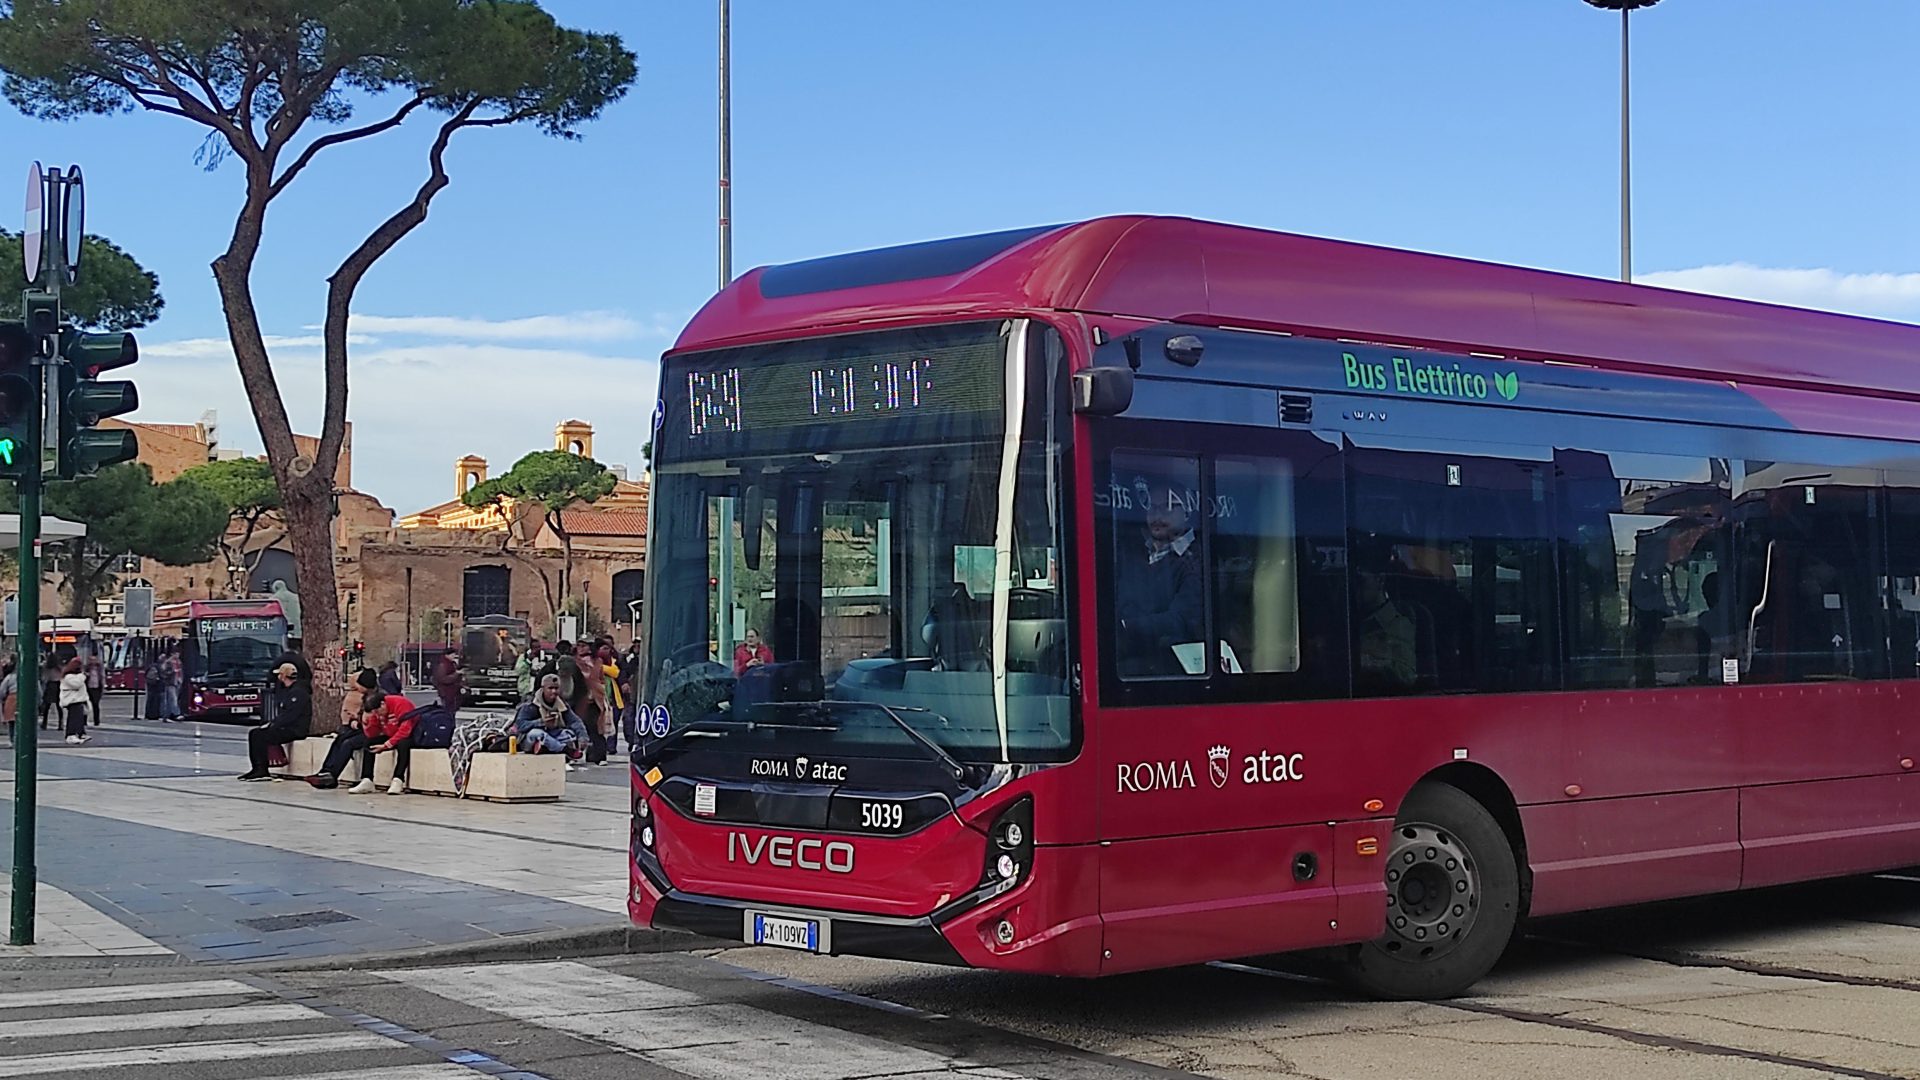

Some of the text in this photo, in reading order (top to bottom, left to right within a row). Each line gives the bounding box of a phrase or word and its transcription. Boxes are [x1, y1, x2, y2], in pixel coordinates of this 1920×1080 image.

[1343, 353, 1488, 399] Bus Elettrico
[751, 759, 848, 781] ROMA atac
[1117, 760, 1197, 793] ROMA
[1243, 750, 1304, 784] atac
[861, 802, 903, 829] 5039
[728, 832, 855, 873] IVECO
